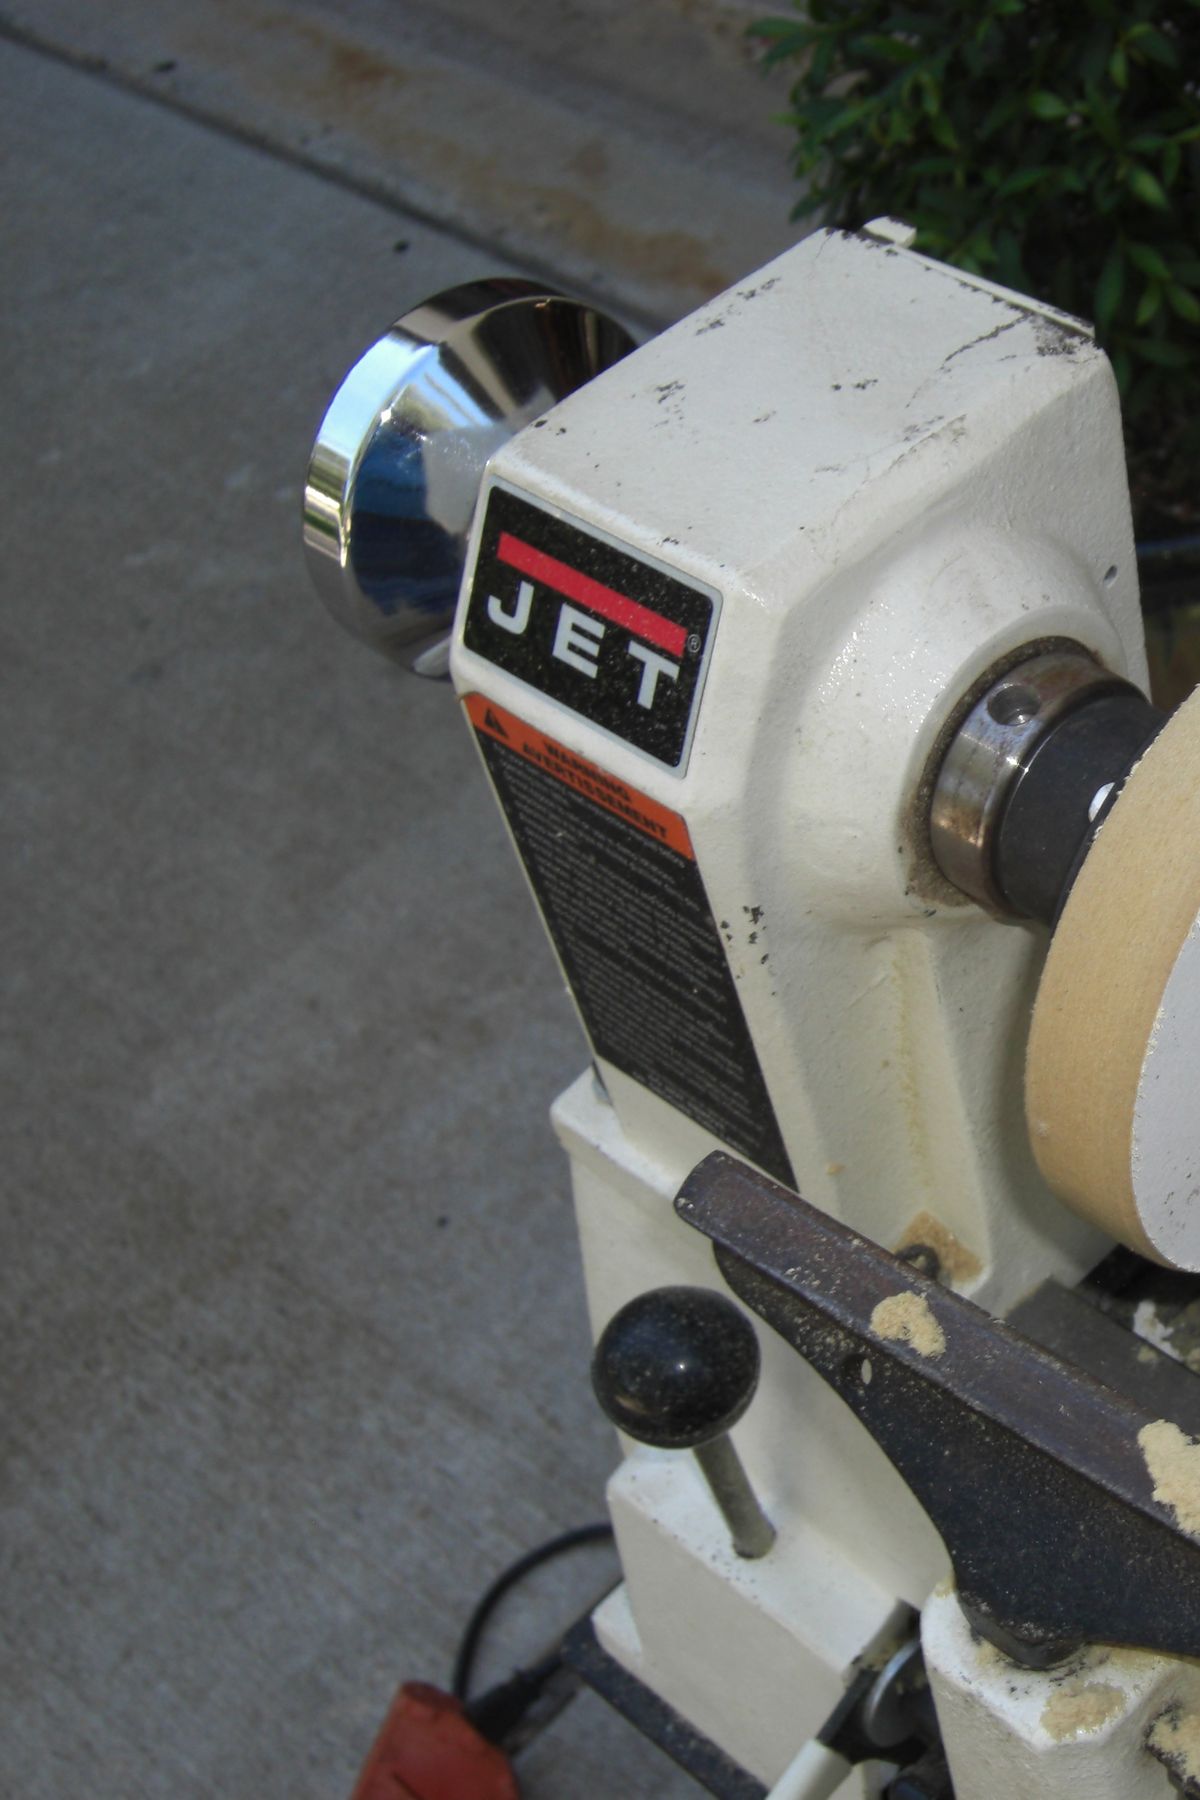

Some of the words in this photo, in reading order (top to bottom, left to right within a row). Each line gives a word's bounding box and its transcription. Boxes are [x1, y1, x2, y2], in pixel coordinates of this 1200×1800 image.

[487, 581, 680, 709] JET
[523, 744, 667, 838] AVERTISSEMENT
[543, 741, 632, 802] WARNING
